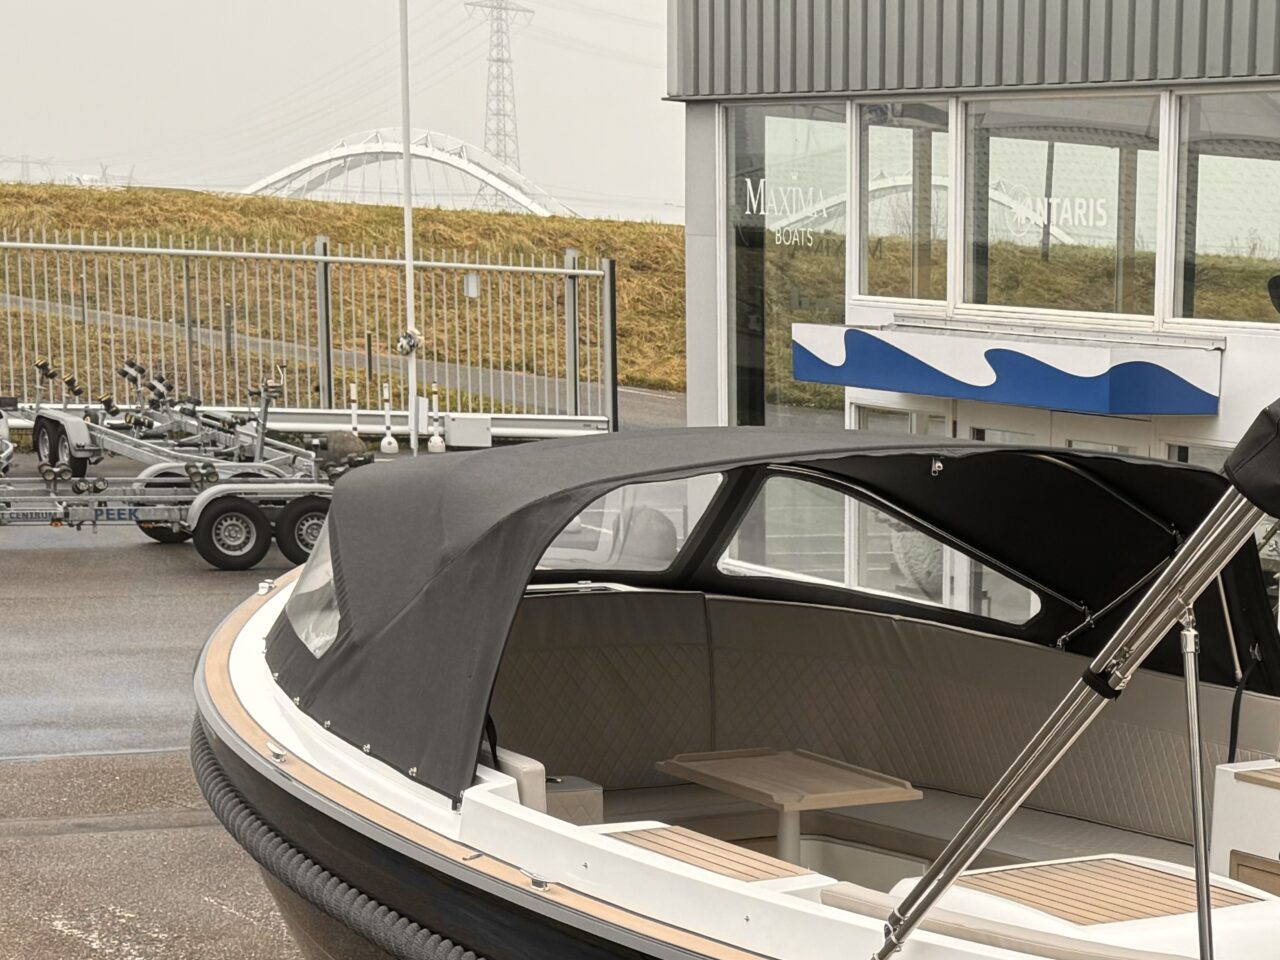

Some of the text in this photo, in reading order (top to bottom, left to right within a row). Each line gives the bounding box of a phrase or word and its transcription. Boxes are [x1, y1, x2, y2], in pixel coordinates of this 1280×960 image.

[745, 178, 828, 218] MAXIMA
[775, 227, 814, 247] BOATS
[94, 508, 140, 521] PEEK
